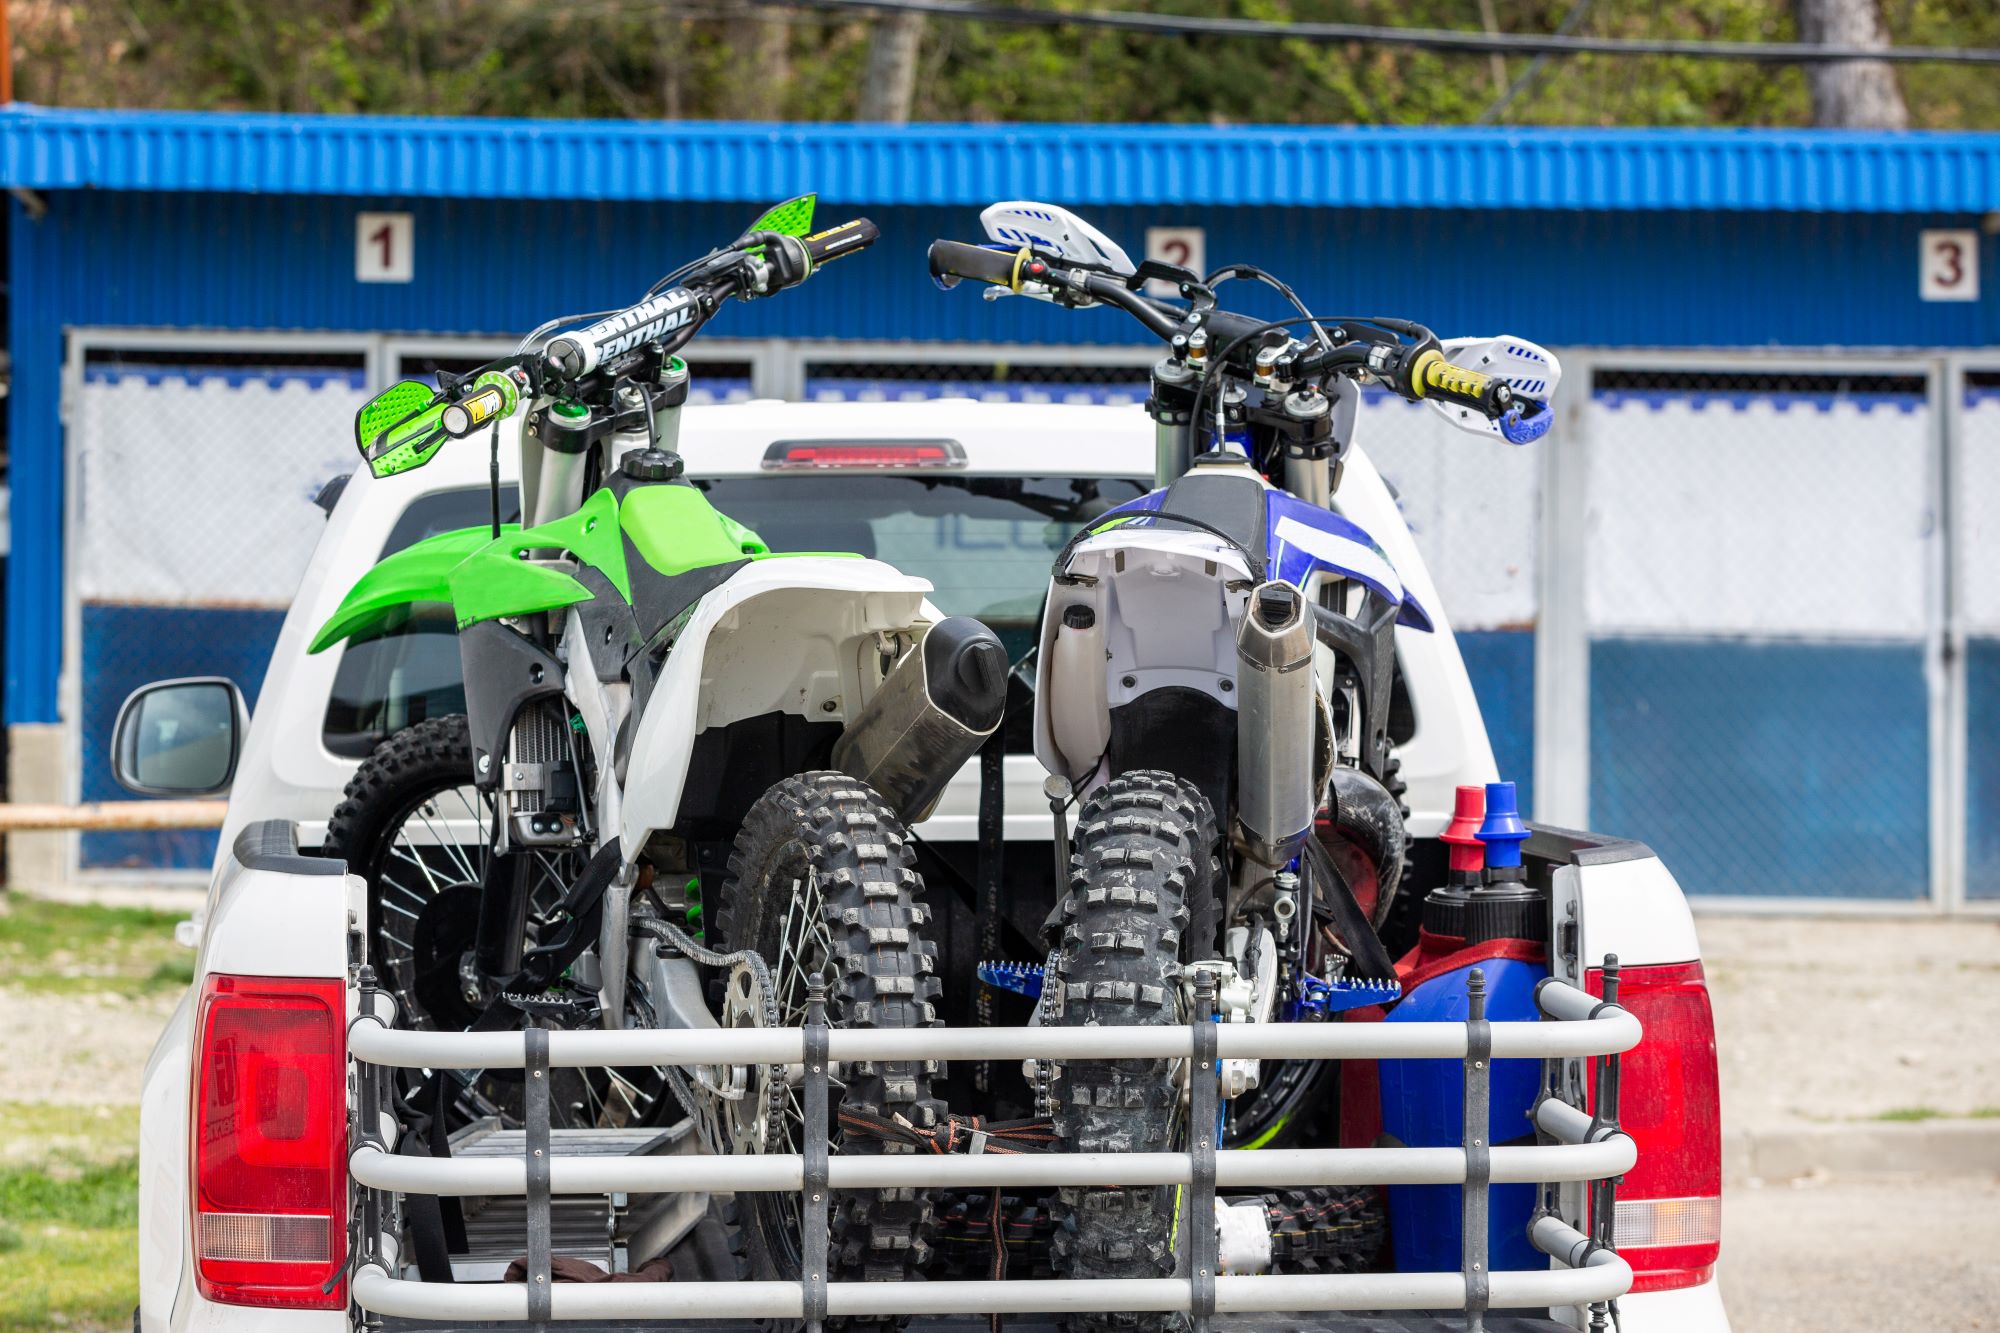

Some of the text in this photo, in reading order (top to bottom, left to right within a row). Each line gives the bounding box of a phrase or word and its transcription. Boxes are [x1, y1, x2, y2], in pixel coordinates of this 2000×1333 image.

[369, 225, 392, 269] 1
[1162, 238, 1191, 284] 2
[1935, 241, 1963, 288] 3
